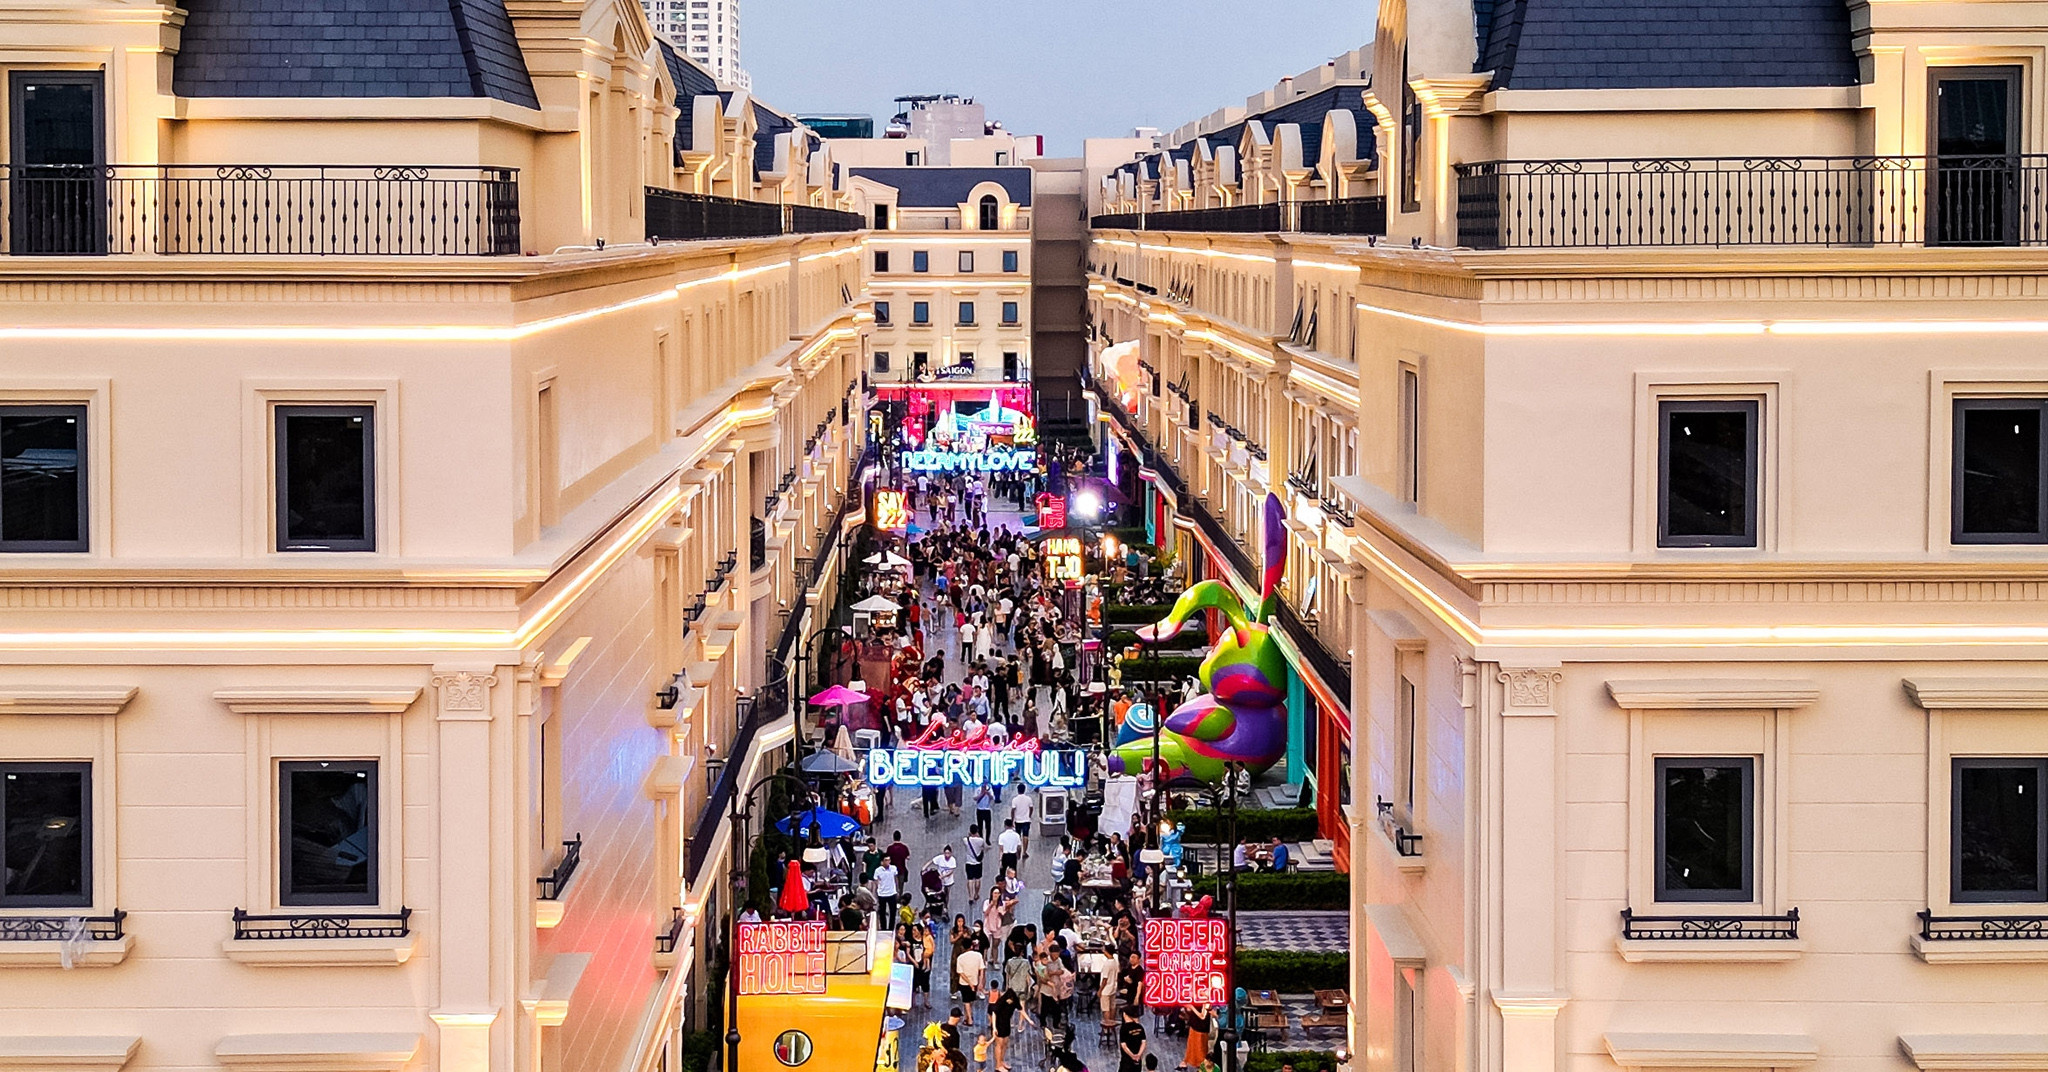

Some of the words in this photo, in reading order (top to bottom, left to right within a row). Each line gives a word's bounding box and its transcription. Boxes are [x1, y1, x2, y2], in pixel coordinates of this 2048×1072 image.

[878, 491, 906, 510] SAY
[877, 510, 907, 529] 222
[1047, 538, 1080, 555] HANG
[1005, 731, 1041, 752] is
[868, 749, 1085, 786] BEERTIFUL!
[739, 922, 826, 953] RABBIT
[1145, 919, 1226, 952] 2BEER
[739, 953, 826, 995] HOLE
